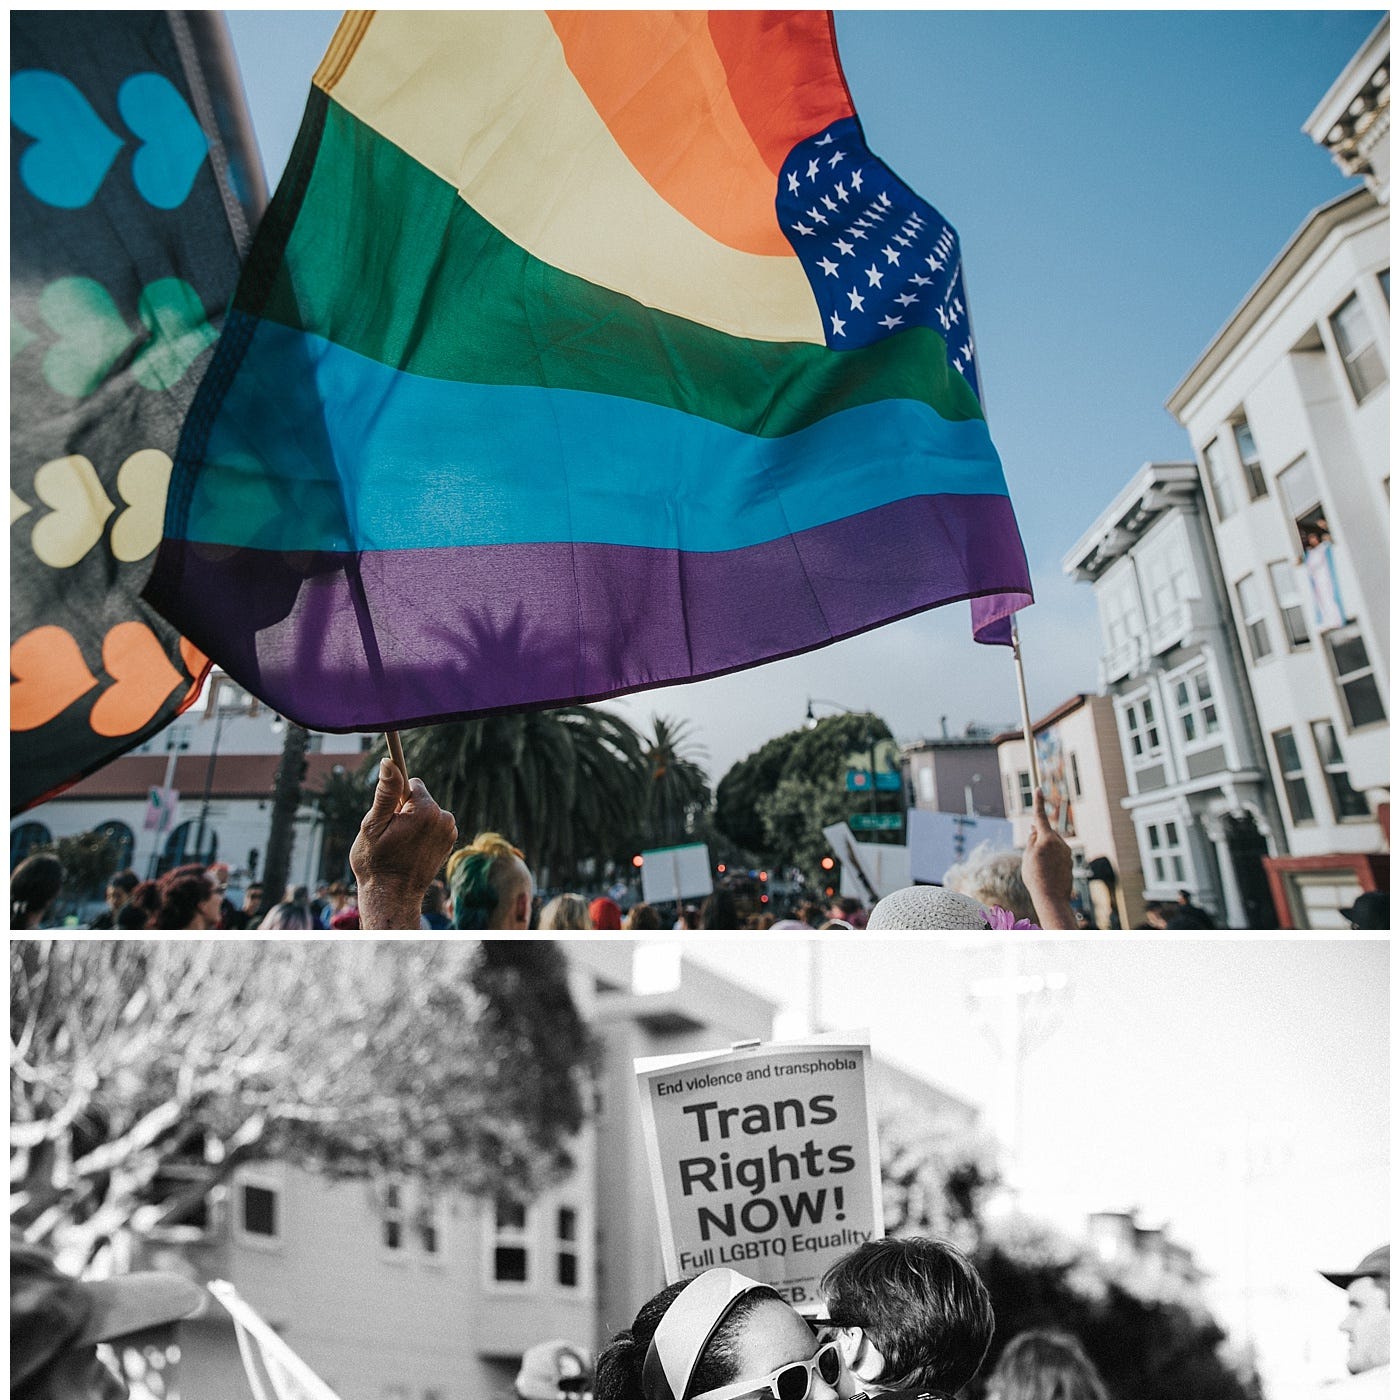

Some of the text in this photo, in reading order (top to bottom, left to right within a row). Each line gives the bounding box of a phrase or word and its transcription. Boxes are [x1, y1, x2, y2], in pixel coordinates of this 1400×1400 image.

[657, 1058, 857, 1097] End violence and transphobia
[683, 1094, 838, 1142] Trans
[679, 1139, 856, 1196] Rights
[697, 1186, 846, 1241] NOW!
[680, 1228, 872, 1270] Full LGBTQ Equality
